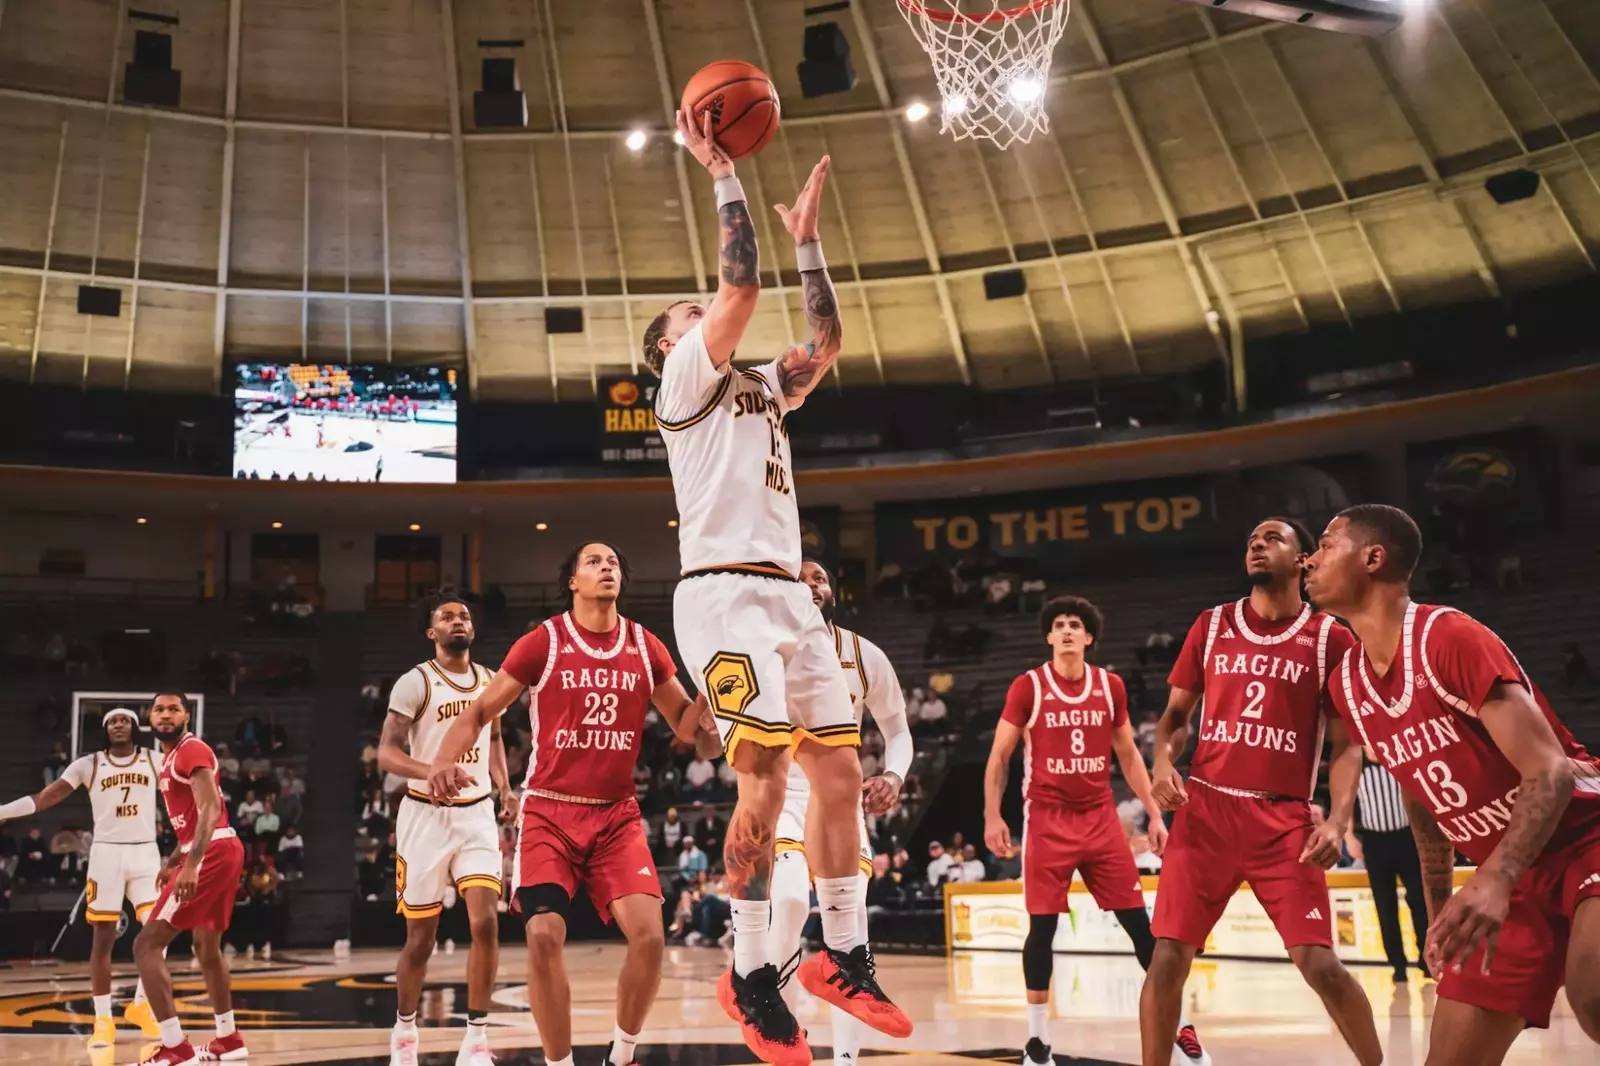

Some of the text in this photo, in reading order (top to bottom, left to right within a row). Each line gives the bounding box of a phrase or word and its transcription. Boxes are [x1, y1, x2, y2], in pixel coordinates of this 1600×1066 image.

[913, 496, 1201, 550] TO THE TOP
[560, 667, 641, 692] RAGIN'
[1214, 653, 1310, 684] RAGIN'
[581, 692, 619, 726] 23
[1240, 681, 1266, 719] 2
[1044, 710, 1107, 728] RAGIN'
[555, 728, 635, 751] CAJUNS
[1071, 728, 1085, 755] 8
[1046, 756, 1106, 774] CAJUNS
[101, 772, 149, 792] SOUTHERN
[121, 786, 130, 803] 7
[1412, 760, 1468, 815] 13
[116, 804, 138, 817] MISS
